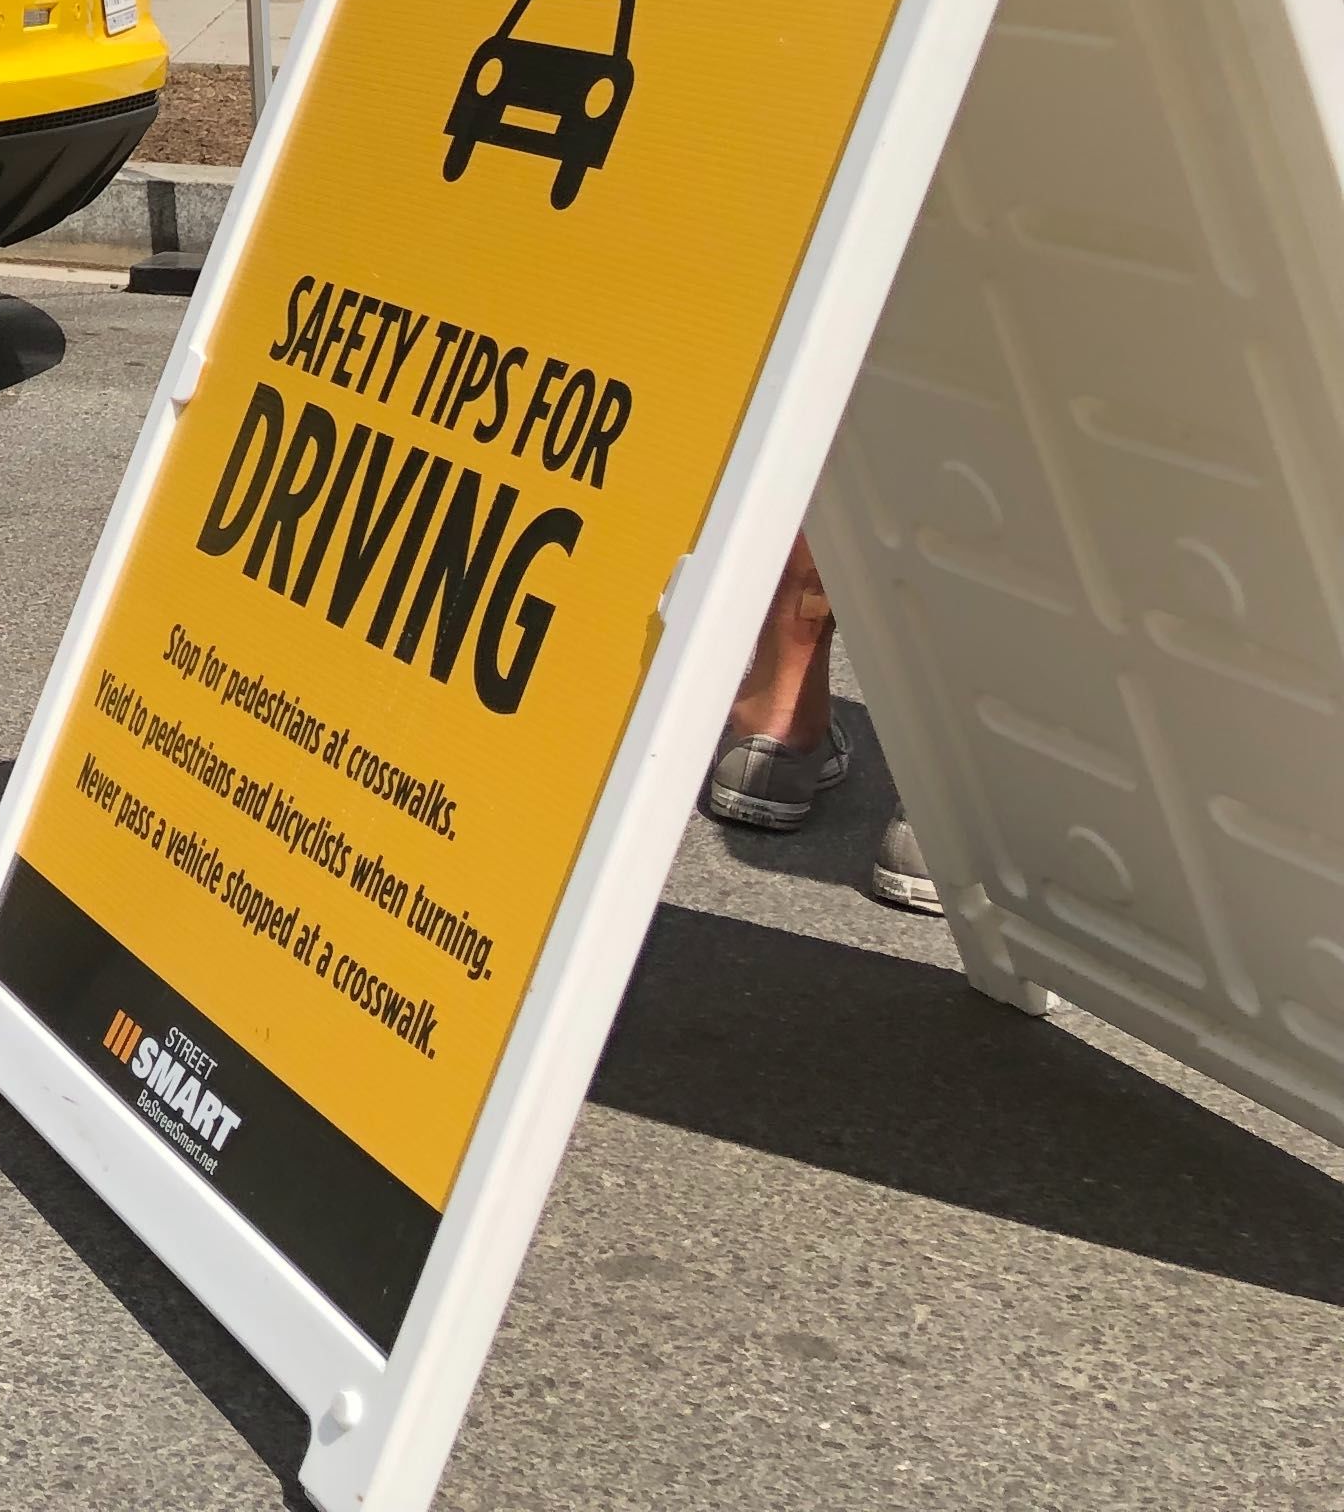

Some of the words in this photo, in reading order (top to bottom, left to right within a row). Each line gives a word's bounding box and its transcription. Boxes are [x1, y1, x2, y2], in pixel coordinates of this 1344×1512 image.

[268, 275, 430, 404] SAFETY
[411, 320, 529, 444] TIPS
[511, 357, 633, 490] FOR
[195, 382, 584, 715] DRIVING
[93, 669, 131, 725] Yield
[128, 695, 146, 737] to
[141, 710, 237, 799] pedestrians
[232, 774, 272, 823] and
[265, 788, 353, 880] bicyclists
[350, 853, 410, 919] when
[406, 883, 494, 982] turning.
[162, 623, 201, 681] Stop
[200, 644, 227, 694] for
[220, 666, 326, 755] pedestrians
[321, 728, 350, 769] at
[346, 744, 458, 841] crosswalks.
[75, 752, 121, 814] Never
[113, 790, 156, 841] pass
[151, 817, 167, 850] a
[165, 826, 224, 895] vehicle
[220, 869, 300, 951] stopped
[293, 923, 321, 967] at
[315, 941, 333, 978] a
[331, 954, 440, 1061] crosswalk.
[131, 1037, 243, 1152] SMART
[136, 1088, 220, 1176] BeStreetSmart.net
[164, 1026, 219, 1081] STREET
